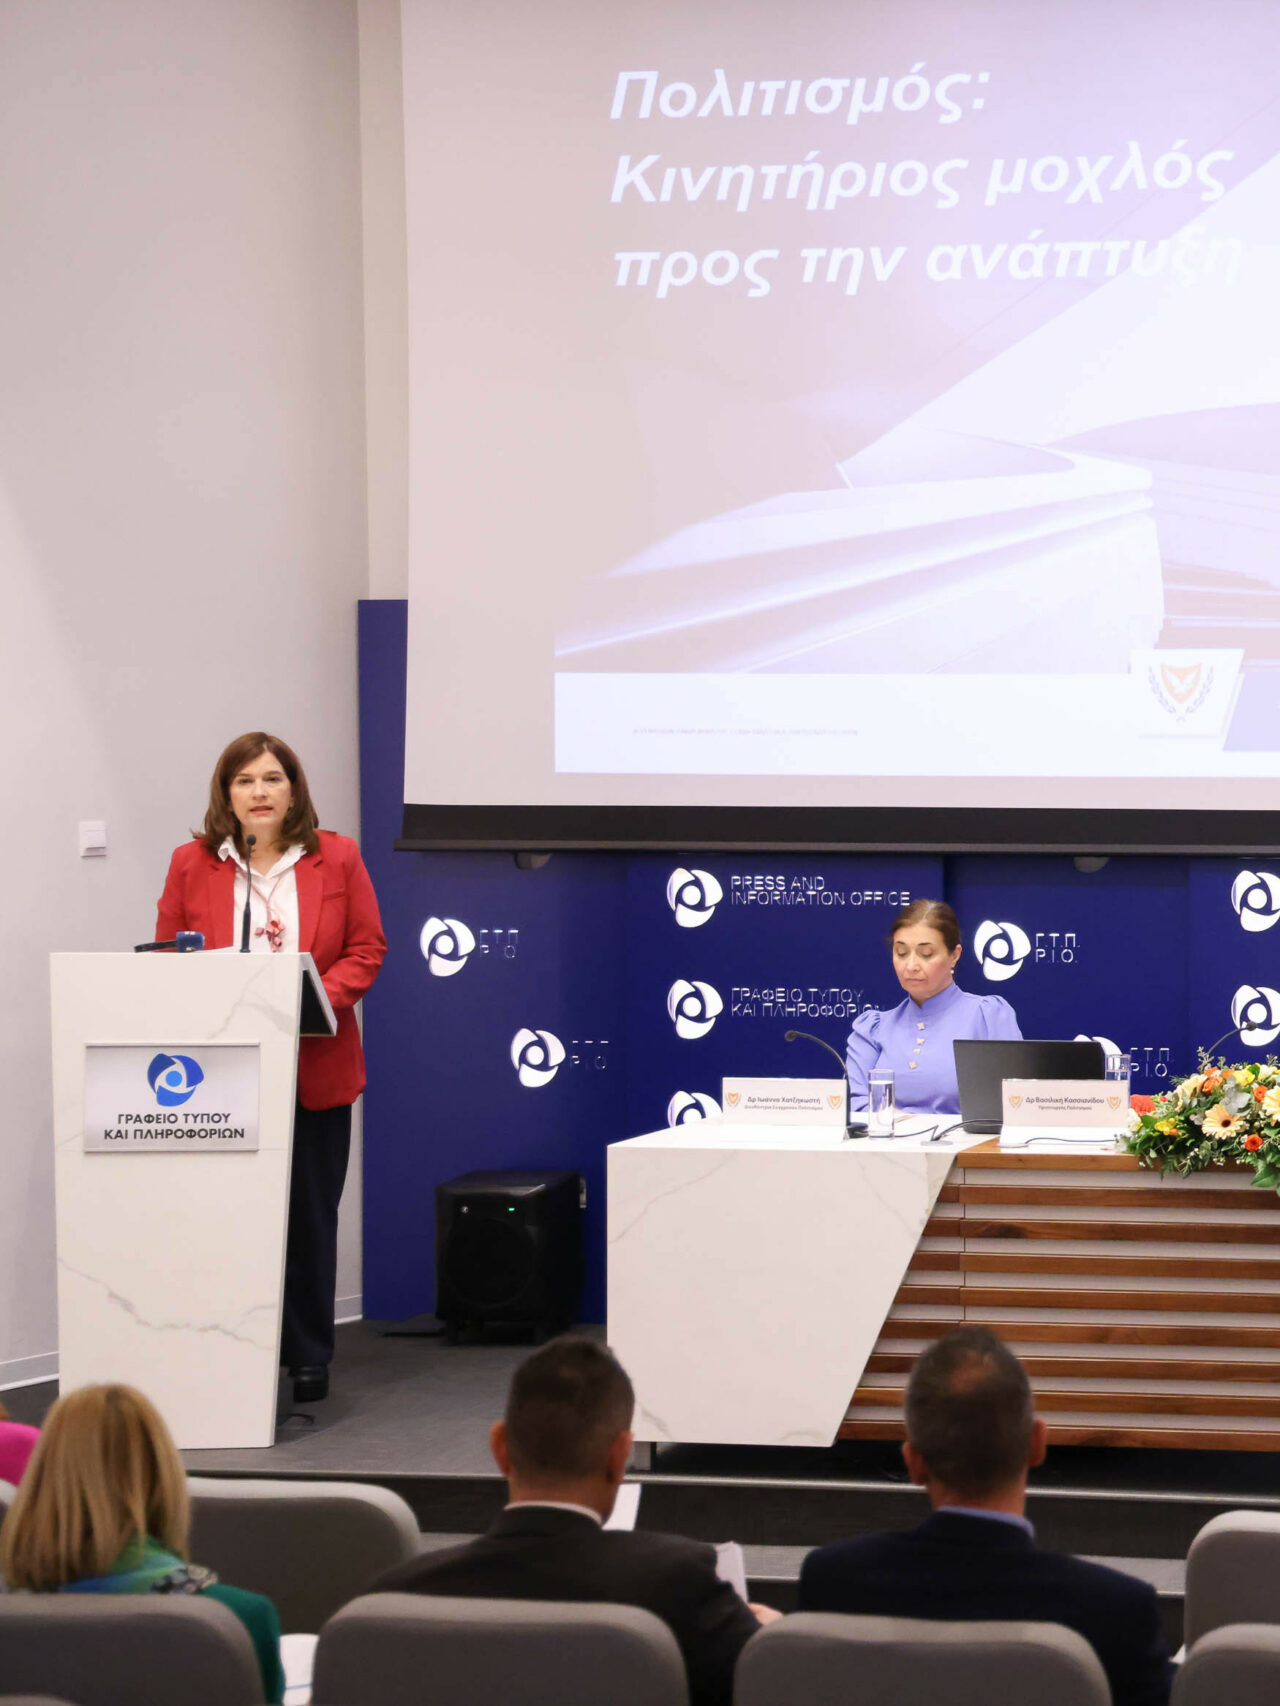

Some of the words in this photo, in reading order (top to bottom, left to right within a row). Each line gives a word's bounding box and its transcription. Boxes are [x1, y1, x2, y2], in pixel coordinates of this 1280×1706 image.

[609, 62, 990, 126] Πολιτισμός:
[610, 150, 967, 213] Κινητήριος
[984, 139, 1235, 207] μοχλός
[614, 249, 780, 299] προς
[800, 245, 907, 296] την
[926, 226, 1245, 288] ανάπτυξη
[731, 875, 786, 890] PRESS
[791, 876, 825, 890] AND
[731, 891, 846, 906] INFORMATION
[850, 891, 911, 906] OFFICE
[731, 988, 803, 1002] ΓΡΑΦΕΙΟ
[808, 988, 864, 1002] ΤΥΠΟΥ
[731, 1003, 756, 1017] ΚΑΙ
[762, 1003, 881, 1017] ΠΛΗΡΟΦΟΡΙ
[747, 1096, 757, 1104] Δρ
[1025, 1096, 1035, 1104] Δρ
[117, 1113, 178, 1125] ΓΡΑΦΕΙΟ
[183, 1112, 231, 1124] ΤΥΠΟΥ
[104, 1129, 129, 1140] ΚΑΙ
[133, 1127, 245, 1140] ΠΛΗΡΟΦΟΡΙΩΝ
